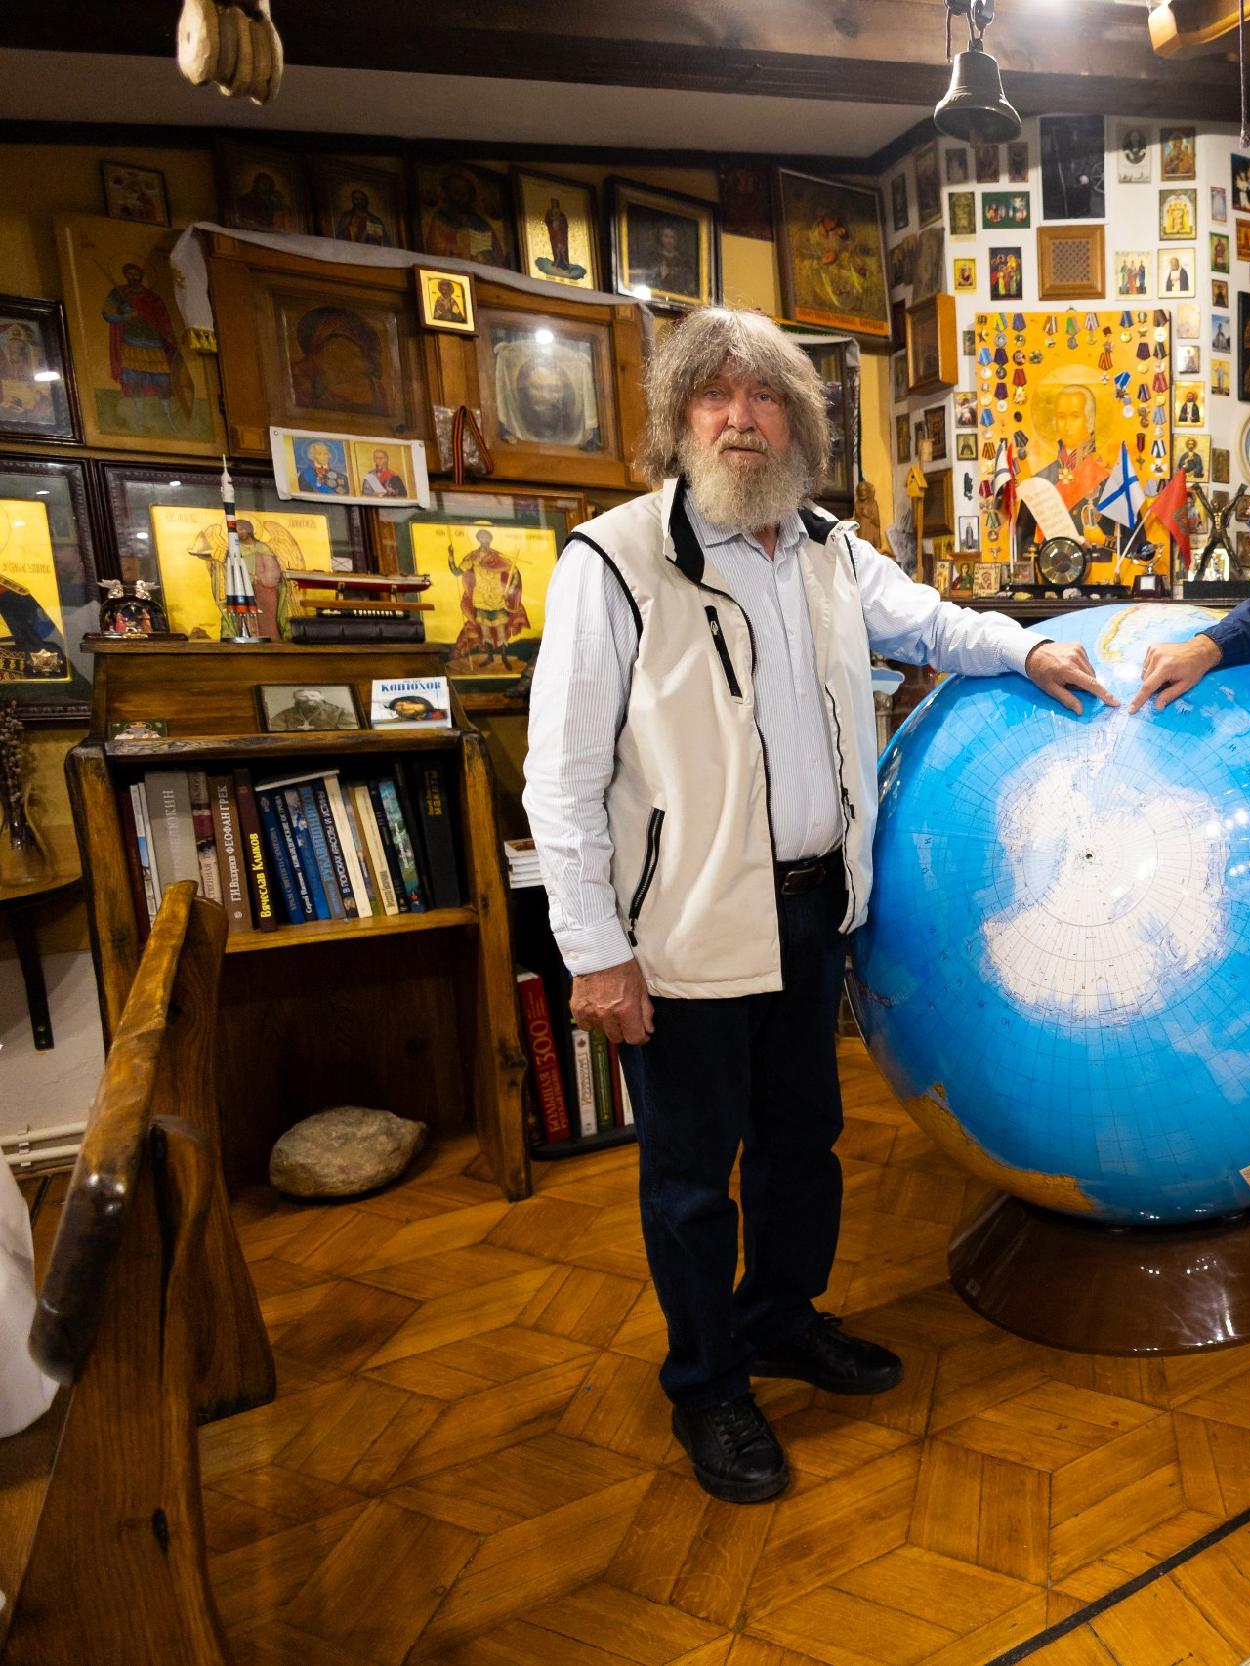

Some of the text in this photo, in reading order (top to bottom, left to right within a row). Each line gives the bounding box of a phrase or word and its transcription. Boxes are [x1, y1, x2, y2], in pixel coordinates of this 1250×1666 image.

[221, 813, 236, 855] ФЕОФАН
[249, 833, 272, 918] Вячеслав Клыков
[528, 1019, 556, 1065] 300
